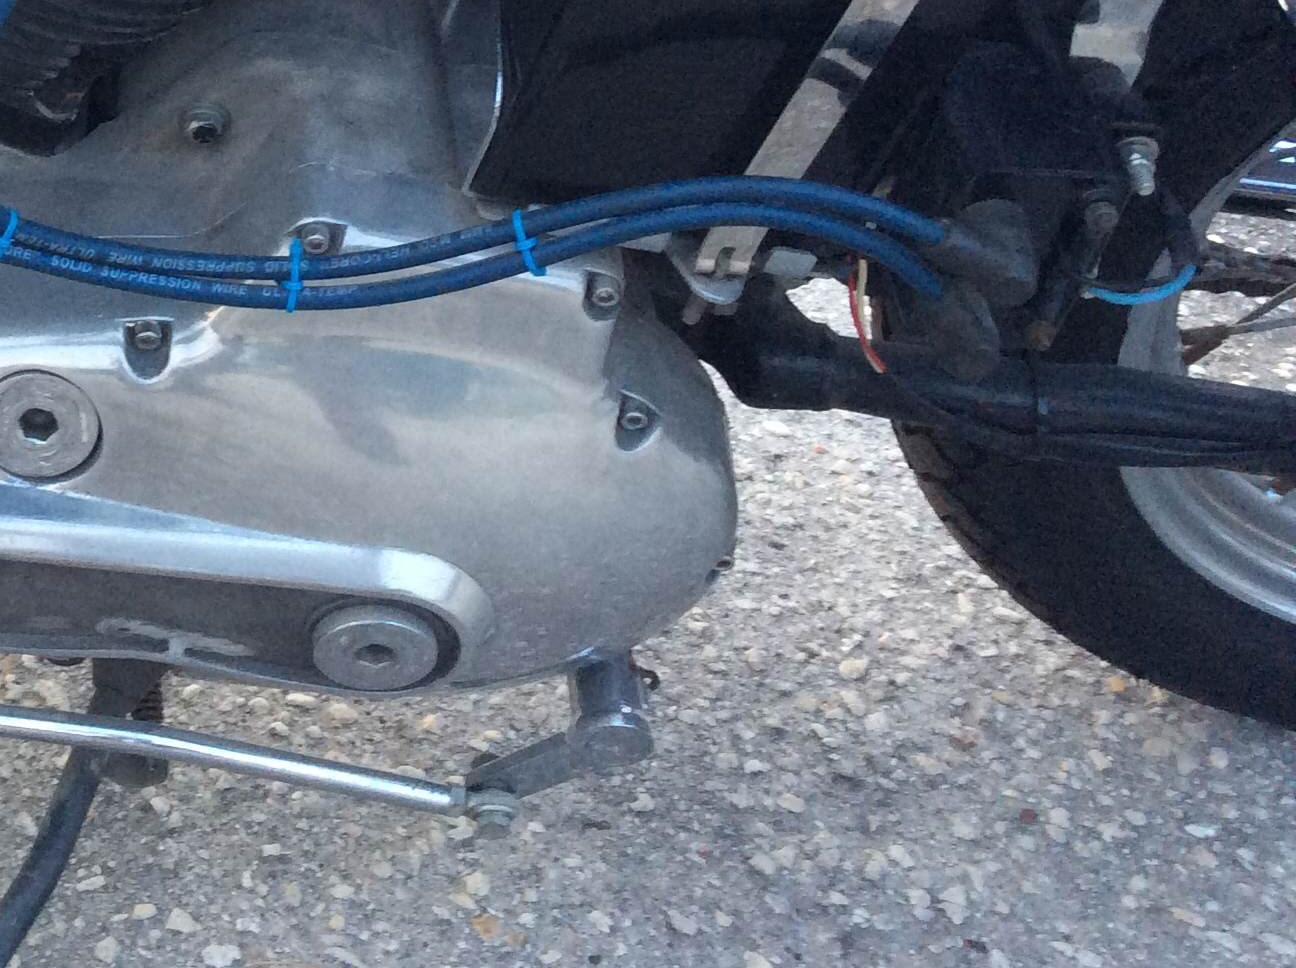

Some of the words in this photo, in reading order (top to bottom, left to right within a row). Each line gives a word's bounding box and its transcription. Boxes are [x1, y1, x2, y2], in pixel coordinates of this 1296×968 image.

[108, 250, 144, 266] WIRE
[153, 254, 255, 273] SUPPRESSION
[264, 258, 310, 274] SLID
[51, 254, 93, 274] SOLID
[100, 267, 202, 291] SUPPRESSION
[211, 282, 249, 296] WIRE
